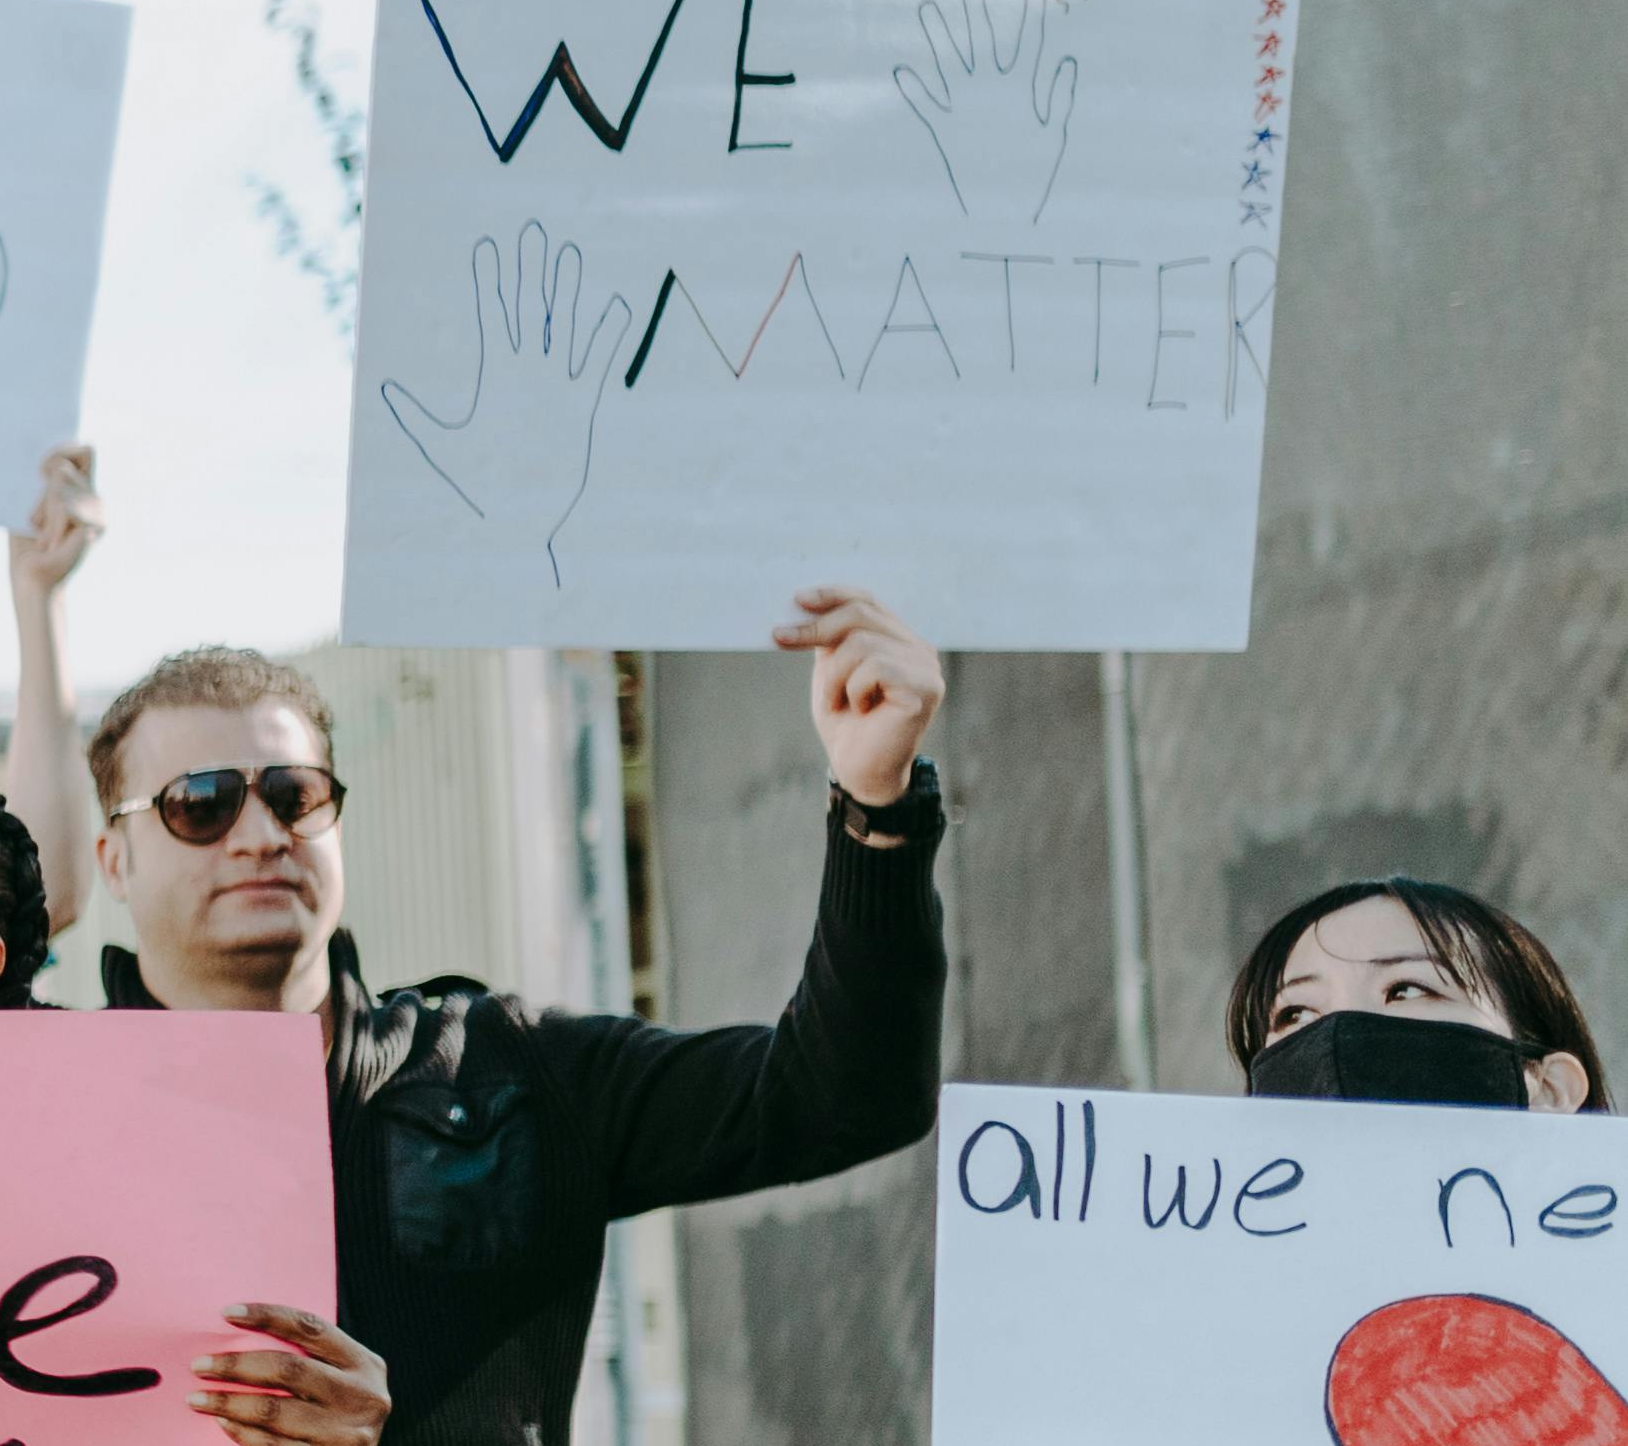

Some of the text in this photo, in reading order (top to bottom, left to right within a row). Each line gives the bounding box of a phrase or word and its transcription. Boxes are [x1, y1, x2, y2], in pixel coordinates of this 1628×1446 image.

[624, 247, 1277, 421] MATTER
[957, 1099, 1098, 1222] all
[1143, 1152, 1309, 1238] we
